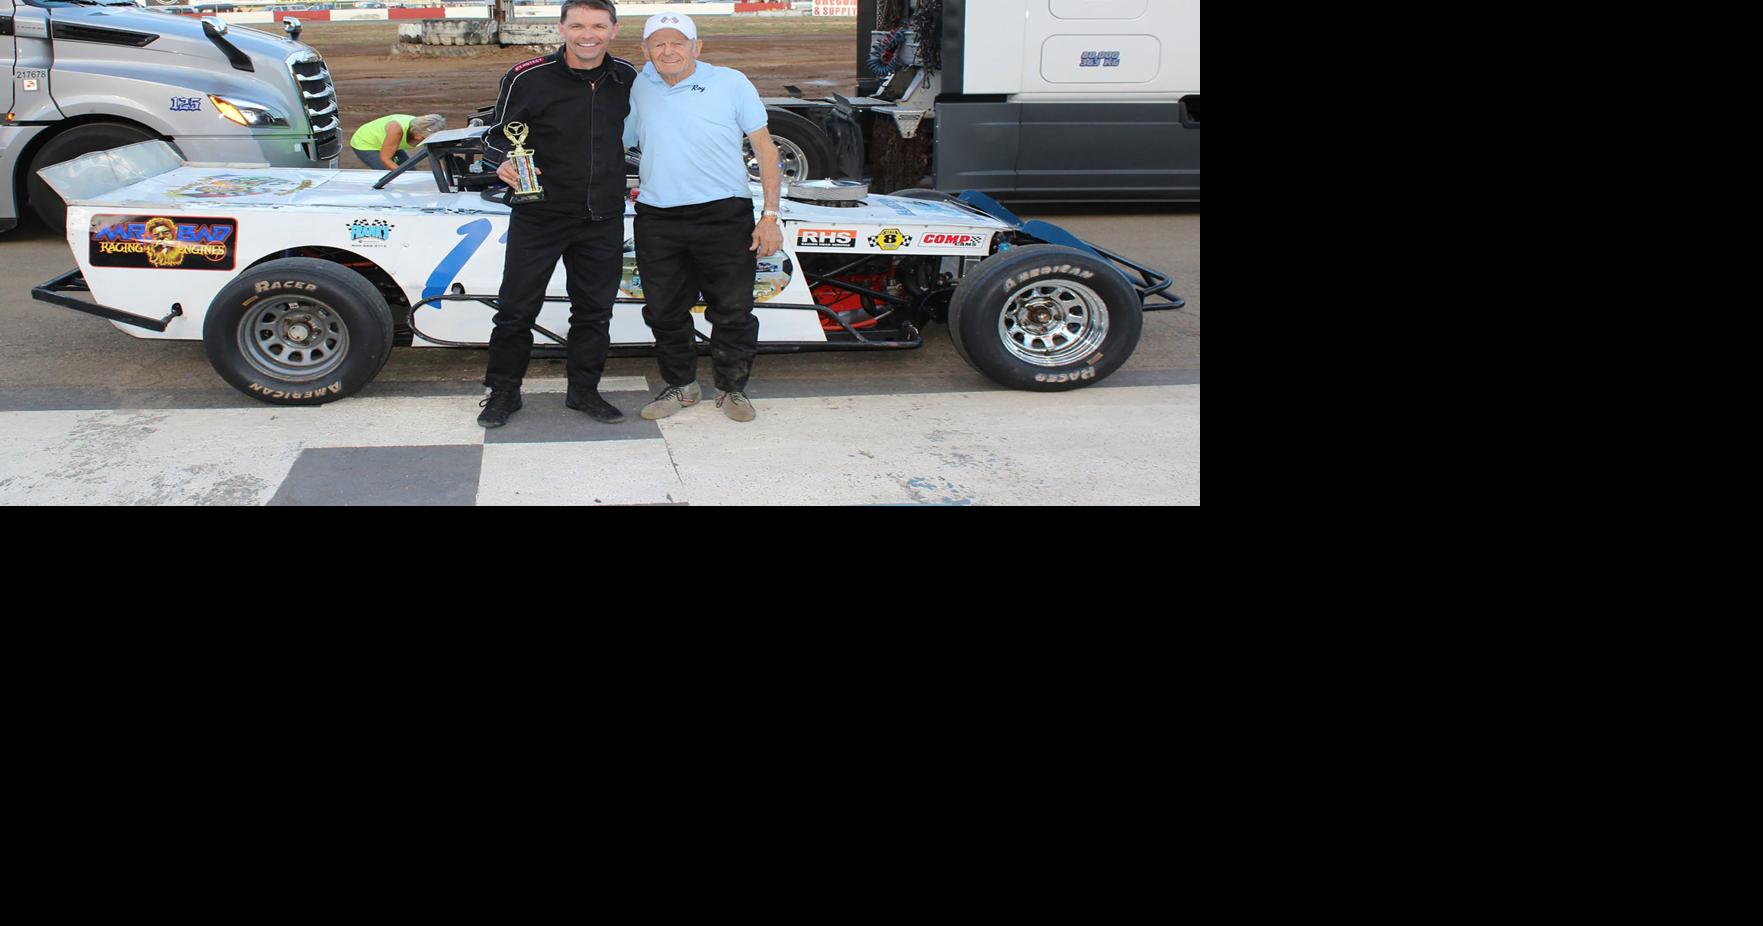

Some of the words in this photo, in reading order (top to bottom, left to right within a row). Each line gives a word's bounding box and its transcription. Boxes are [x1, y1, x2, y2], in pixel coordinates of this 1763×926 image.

[814, 7, 820, 15] &
[822, 7, 857, 16] SUPPLY
[16, 71, 47, 79] 217678
[690, 84, 706, 93] Roy
[170, 97, 202, 111] 125
[176, 223, 232, 242] BAD
[801, 231, 852, 244] RHS
[883, 234, 897, 244] 8
[923, 234, 970, 244] COMP
[99, 242, 144, 254] RACING
[255, 280, 318, 294] RACER
[248, 381, 342, 399] AMERICAN
